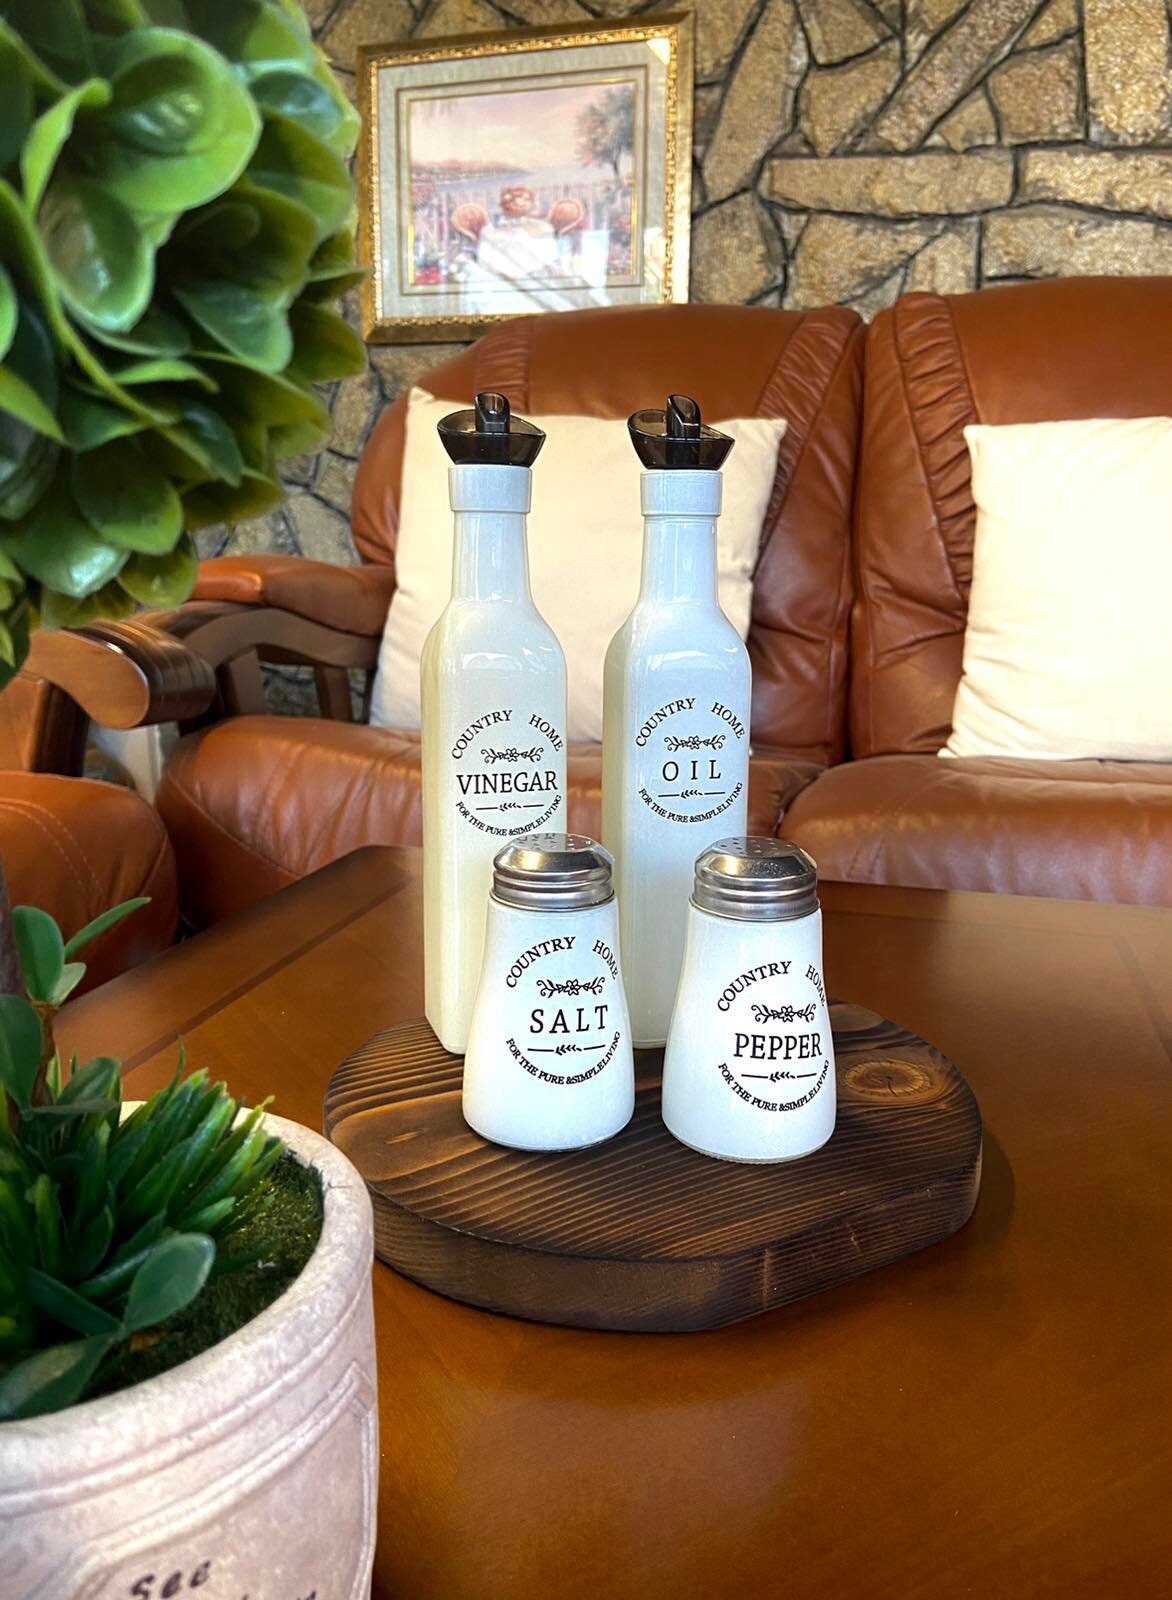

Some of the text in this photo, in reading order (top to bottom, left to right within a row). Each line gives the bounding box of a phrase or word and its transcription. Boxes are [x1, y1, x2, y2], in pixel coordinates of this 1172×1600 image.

[451, 709, 564, 760] COUNTRY HOME
[636, 698, 745, 747] COUNTRY HOME
[456, 771, 558, 795] VINEGAR
[662, 759, 721, 782] OIL
[456, 801, 468, 819] FOR
[468, 815, 486, 831] THE
[485, 825, 508, 837] PURE
[638, 788, 653, 806] FOR
[651, 802, 667, 817] THE
[667, 813, 689, 823] PURE
[506, 936, 619, 988] COUNTRY HOME
[717, 961, 792, 1012] COUNTRY
[529, 1004, 608, 1034] SALT
[506, 1038, 520, 1060] FOR
[519, 1056, 538, 1076] THE
[538, 1070, 565, 1085] PURE
[733, 1032, 822, 1060] PEPPER
[718, 1062, 732, 1085] FOR
[731, 1082, 750, 1102] THE
[751, 1096, 777, 1112] PURE
